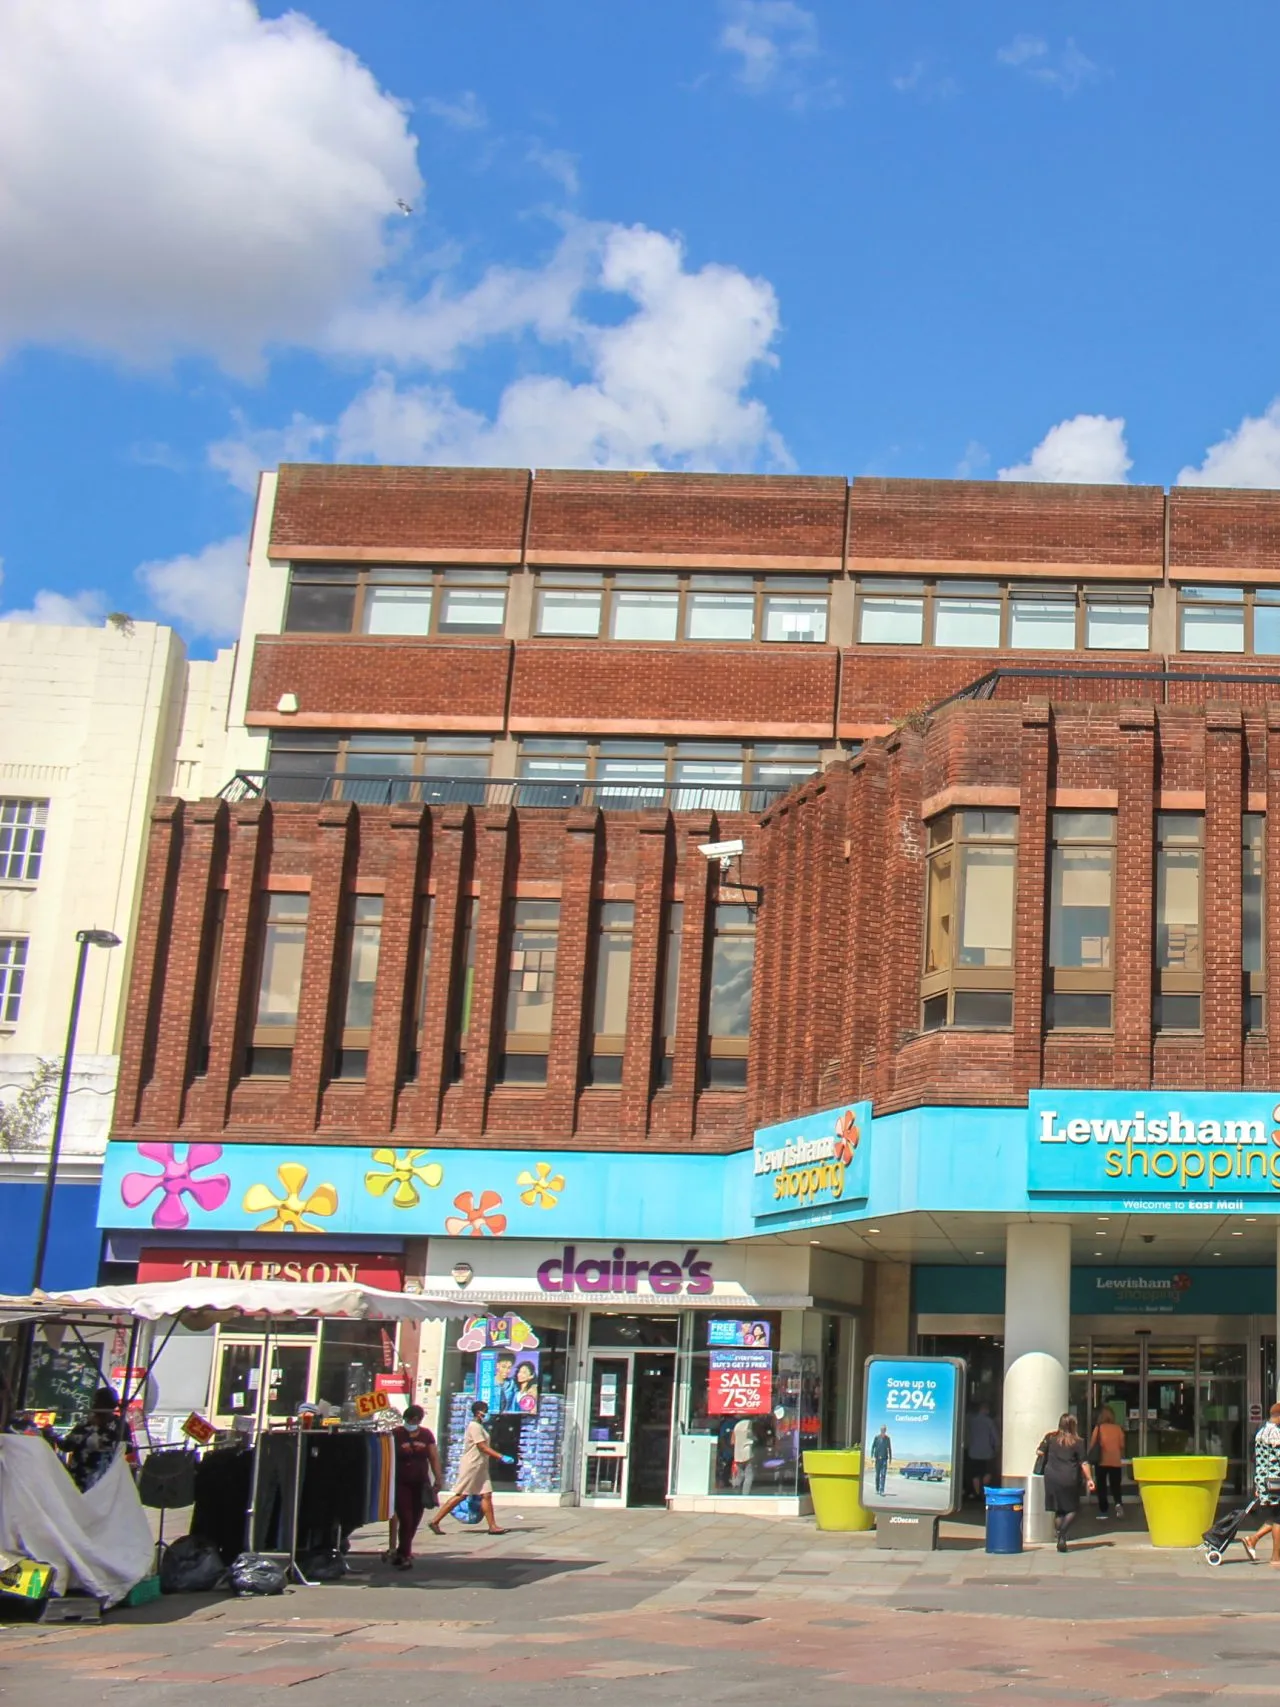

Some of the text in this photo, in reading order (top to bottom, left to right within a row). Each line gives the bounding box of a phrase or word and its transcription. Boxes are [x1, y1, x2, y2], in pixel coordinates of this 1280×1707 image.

[1039, 1111, 1268, 1145] Lewisham
[754, 1136, 835, 1175] Lewisham
[773, 1161, 844, 1204] shopping
[1123, 1199, 1243, 1210] Welcome to East Mall
[182, 1259, 359, 1283] TIMPSON
[537, 1246, 715, 1295] claire's
[1096, 1277, 1171, 1289] Lewisham
[711, 1323, 737, 1333] FREE
[720, 1373, 761, 1388] SALE
[887, 1377, 937, 1390] Save up to
[360, 1393, 387, 1413] £10
[721, 1388, 760, 1407] 75%
[886, 1389, 936, 1410] £294
[889, 1516, 919, 1524] JCDecaux
